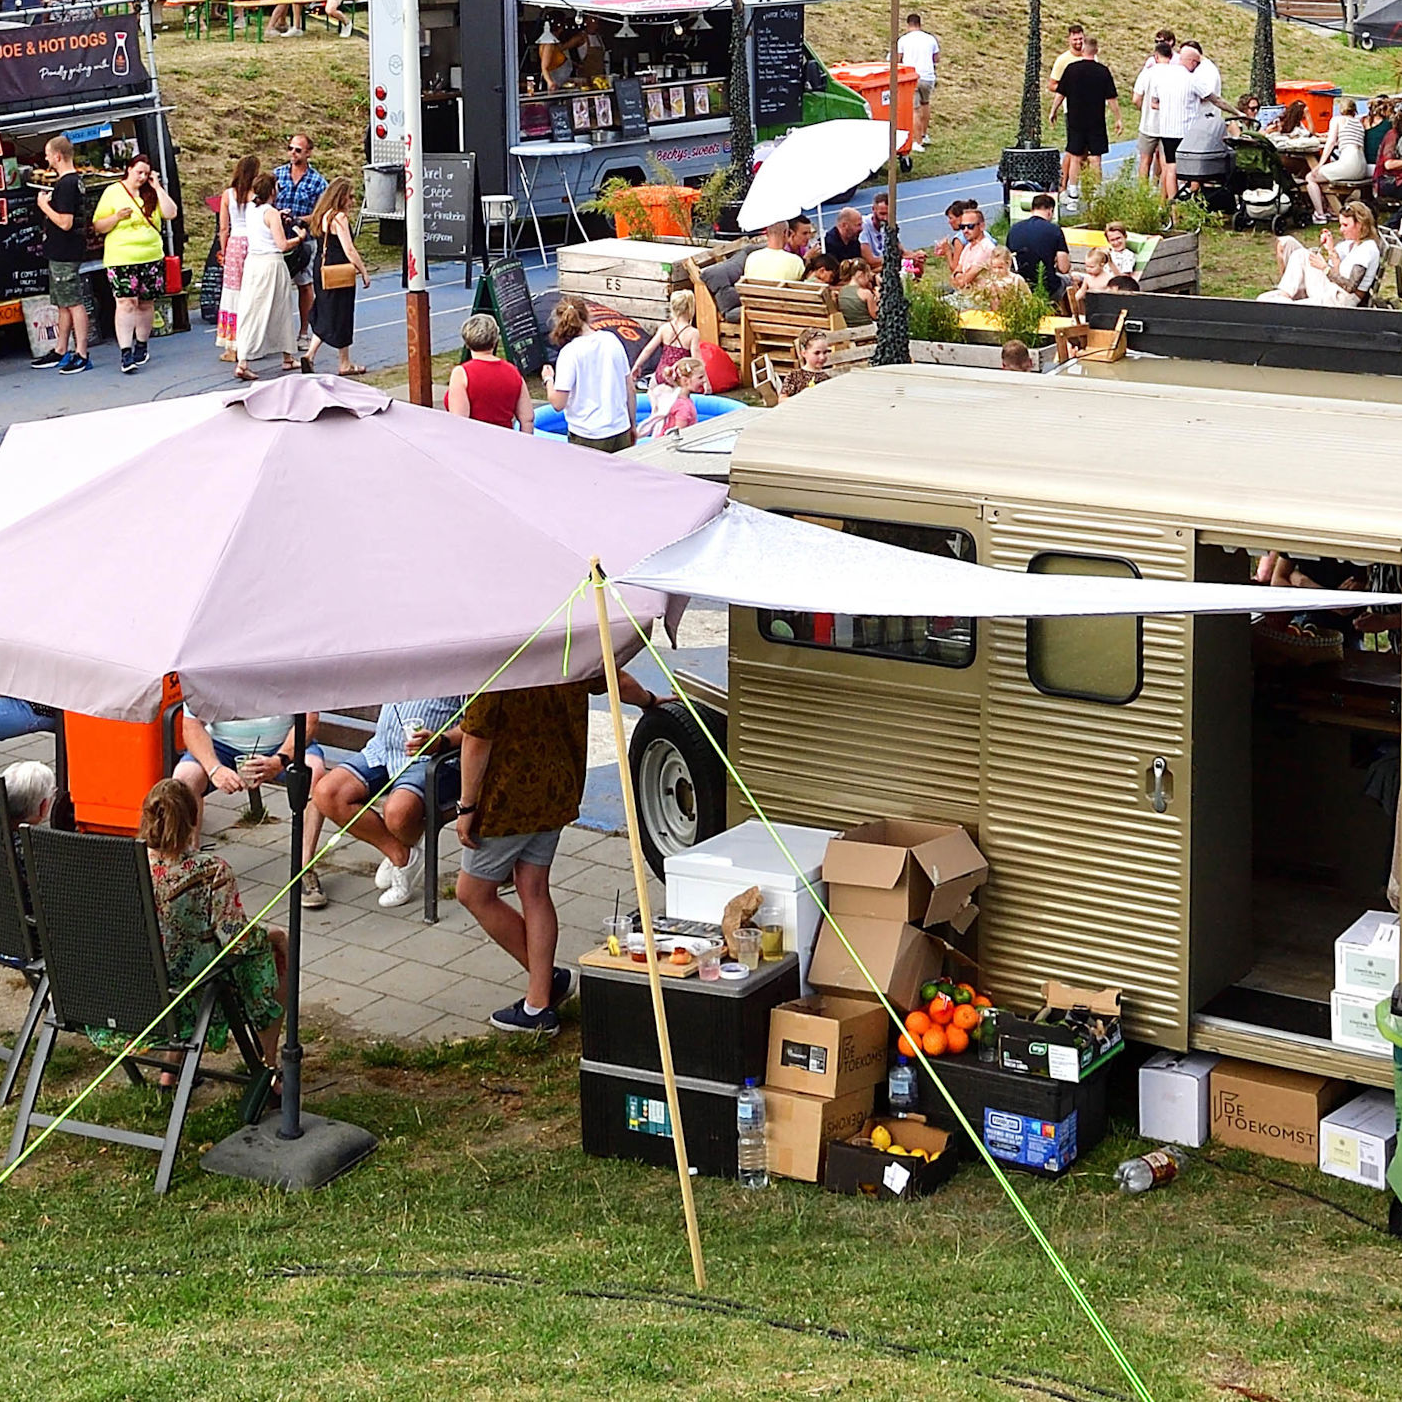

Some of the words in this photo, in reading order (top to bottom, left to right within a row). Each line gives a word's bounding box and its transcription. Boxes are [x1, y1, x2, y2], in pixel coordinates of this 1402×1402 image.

[26, 43, 36, 55] &
[38, 39, 66, 54] HOT
[69, 31, 108, 49] DOGS
[606, 278, 622, 291] ES
[1224, 1102, 1245, 1117] DE
[1225, 1115, 1316, 1146] TOEKOMST
